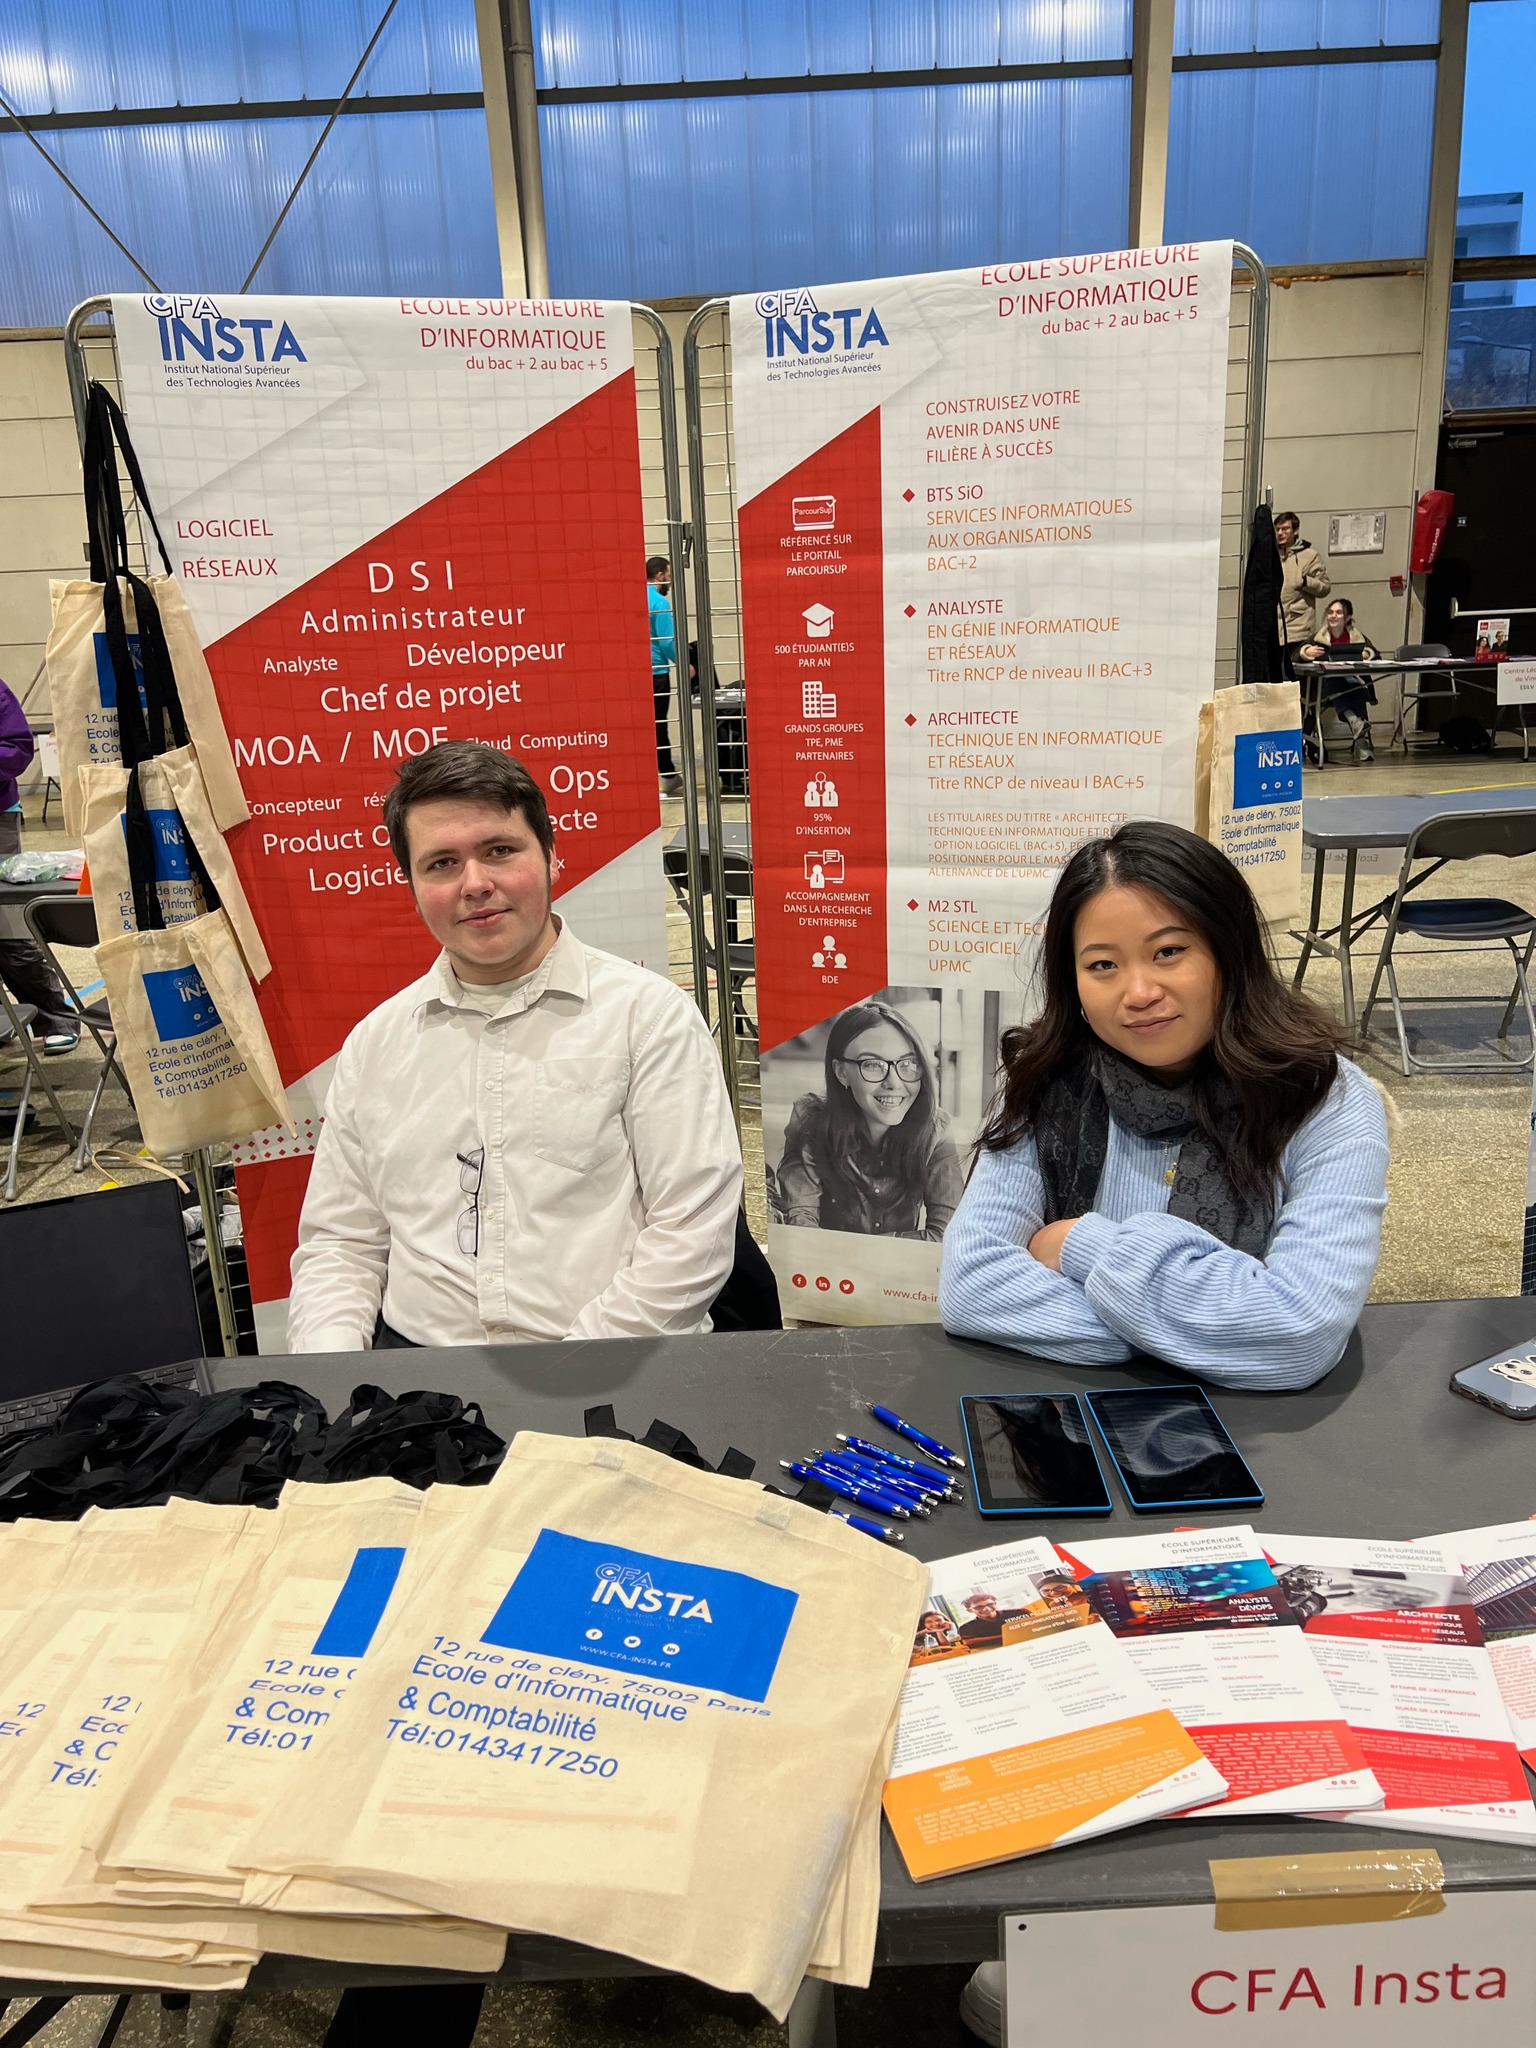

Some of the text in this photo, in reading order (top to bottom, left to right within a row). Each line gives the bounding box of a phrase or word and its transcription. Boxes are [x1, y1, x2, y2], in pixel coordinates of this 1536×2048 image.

[756, 288, 818, 319] CFA
[999, 275, 1198, 317] D'INFORMATIQUE
[143, 295, 221, 319] CFA
[158, 317, 308, 363] INSTA
[421, 328, 606, 351] D'INFORMATIQUE
[765, 307, 889, 358] INSTA
[164, 364, 290, 376] Institut National Supérieur
[166, 378, 300, 389] des Technologies Avancées
[926, 390, 1081, 416] CONSTRUISEZ VOTRE
[926, 416, 1060, 440] AVENIR DANS UNE
[926, 439, 1053, 464] FILIÈRE À SUCCÈS
[927, 487, 953, 502] BTS
[927, 498, 1132, 525] SERVICES INFORMATIQUES
[177, 519, 273, 539] LOGICIEL
[928, 525, 1092, 548] AUX ORGANISATIONS
[780, 534, 852, 547] RÉFÉRENCÉ SUR
[791, 550, 841, 561] LE PORTAIL
[927, 556, 977, 571] BAC+2
[183, 558, 278, 578] RÉSEAUX
[786, 564, 847, 576] PARCOURSUP
[927, 599, 1003, 616] ANALYSTE
[301, 605, 526, 634] Administrateur
[928, 617, 1120, 639] EN GÉNIE INFORMATIQUE
[407, 640, 566, 668] Développeur
[775, 642, 854, 654] 500 ÉTUDIANT(E)S
[928, 644, 1016, 660] ET RÉSEAUX
[263, 656, 338, 676] Analyste
[798, 658, 831, 667] PAR AN
[927, 668, 960, 682] Titre
[964, 667, 1005, 681] RNCP
[1008, 665, 1028, 680] de
[1032, 664, 1082, 680] niveau
[1100, 662, 1153, 677] BAC+3
[320, 679, 522, 713] Chef de projet
[928, 711, 1019, 726] ARCHITECTE
[784, 723, 864, 733] GRANDS GROUPES
[520, 731, 609, 752] Computing
[805, 738, 843, 748] TPE, PME
[928, 730, 1162, 749] TECHNIQUE EN INFORMATIQUE
[234, 734, 321, 767] MOA
[796, 751, 854, 761] PARTENAIRES
[1258, 750, 1300, 768] INSTA
[928, 753, 1015, 769] ET RÉSEAUX
[550, 765, 610, 798] Ops
[928, 775, 959, 790] Titre
[964, 776, 1004, 789] RNCP
[1007, 775, 1026, 789] de
[1030, 775, 1080, 789] niveau
[1092, 775, 1144, 789] BAC+5
[813, 813, 832, 822] 95%
[1232, 814, 1244, 823] rue
[1245, 811, 1255, 822] de
[1279, 805, 1301, 817] 75002
[796, 826, 850, 835] D'INSERTION
[1244, 821, 1300, 836] d'Informatique
[263, 828, 364, 855] Product
[1227, 837, 1277, 853] Comptabilité
[309, 861, 409, 895] Logicie
[928, 868, 993, 878] ALTERNANCE
[996, 868, 1009, 878] DE
[785, 892, 870, 902] ACCOMPAGNEMENT
[783, 905, 872, 915] DANS LA RECHERCHE
[928, 900, 978, 914] M2 STL
[799, 918, 857, 928] D'ENTREPRISE
[928, 920, 990, 934] SCIENCE
[994, 921, 1011, 934] ET
[928, 940, 1020, 956] DU LOGICIEL
[928, 959, 971, 973] UPMC
[822, 975, 838, 984] BDE
[146, 1049, 160, 1058] 12
[162, 1046, 178, 1055] rue
[180, 1042, 193, 1052] de
[149, 1039, 236, 1073] Ecole d'Informat
[153, 1054, 231, 1085] & Comptabilité
[156, 1063, 248, 1099] Tél:0143417250
[595, 1562, 654, 1590] CFA
[591, 1579, 713, 1624] INSTA
[1228, 1597, 1270, 1606] ANALYSTE
[1397, 1610, 1461, 1621] ARCHITECTE
[264, 1659, 340, 1679] 12 rue
[432, 1635, 461, 1658] 12
[464, 1649, 504, 1664] rue
[511, 1654, 542, 1672] de
[622, 1679, 700, 1705] 75002
[707, 1699, 772, 1718] Paris
[248, 1679, 325, 1696] Ecole
[412, 1655, 688, 1722] Ecole d'Informatique
[100, 1695, 131, 1712] 12
[235, 1697, 255, 1718] &
[399, 1686, 598, 1742] & Comptabilité
[385, 1718, 619, 1779] Tél:0143417250
[1191, 1963, 1507, 2015] CFA Insta
